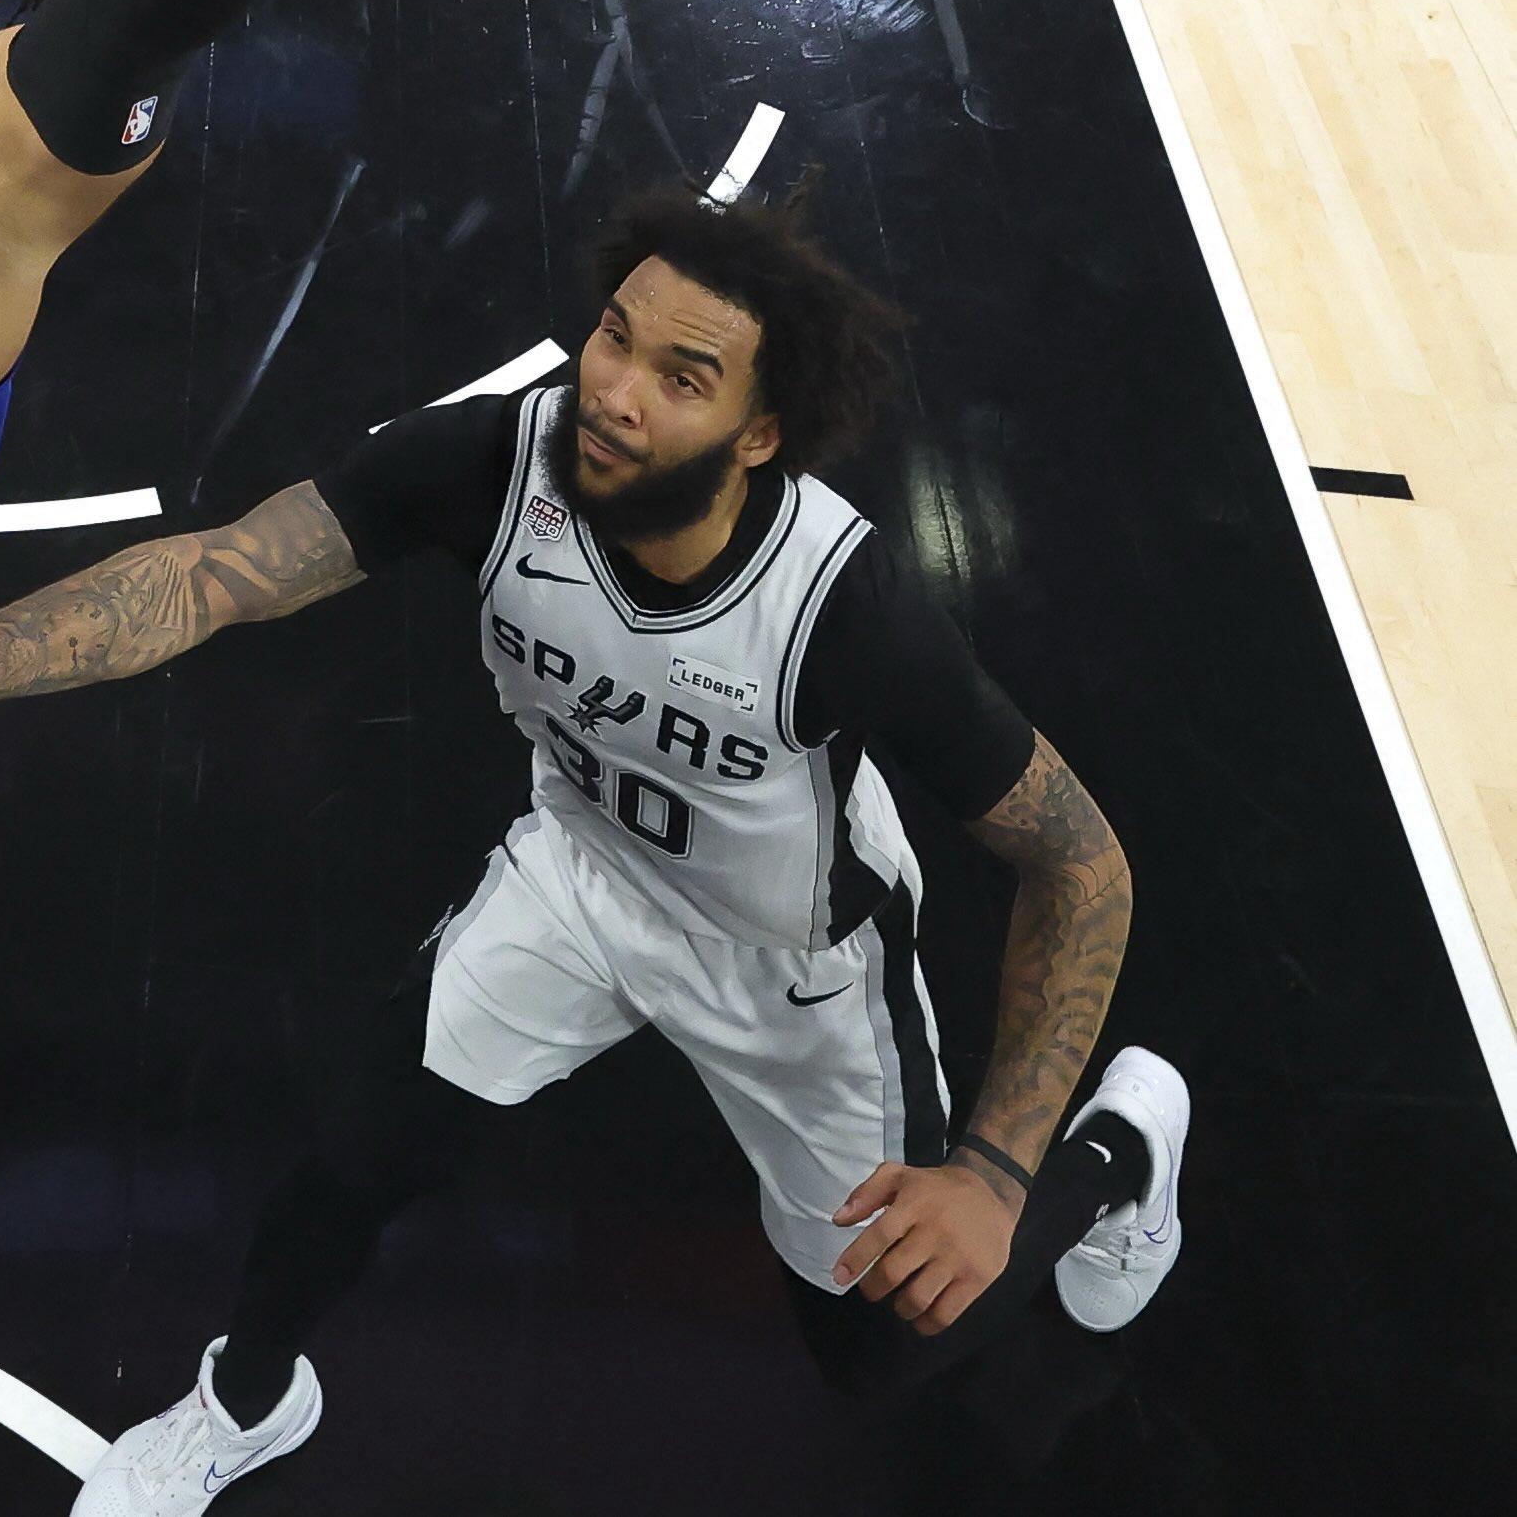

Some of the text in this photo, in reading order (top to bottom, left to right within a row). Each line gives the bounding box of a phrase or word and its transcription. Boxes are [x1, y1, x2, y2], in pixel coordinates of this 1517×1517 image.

[523, 512, 560, 537] 250
[533, 498, 563, 522] USA
[492, 614, 769, 781] SPURS
[680, 669, 745, 702] LEDGER
[544, 714, 694, 860] 30
